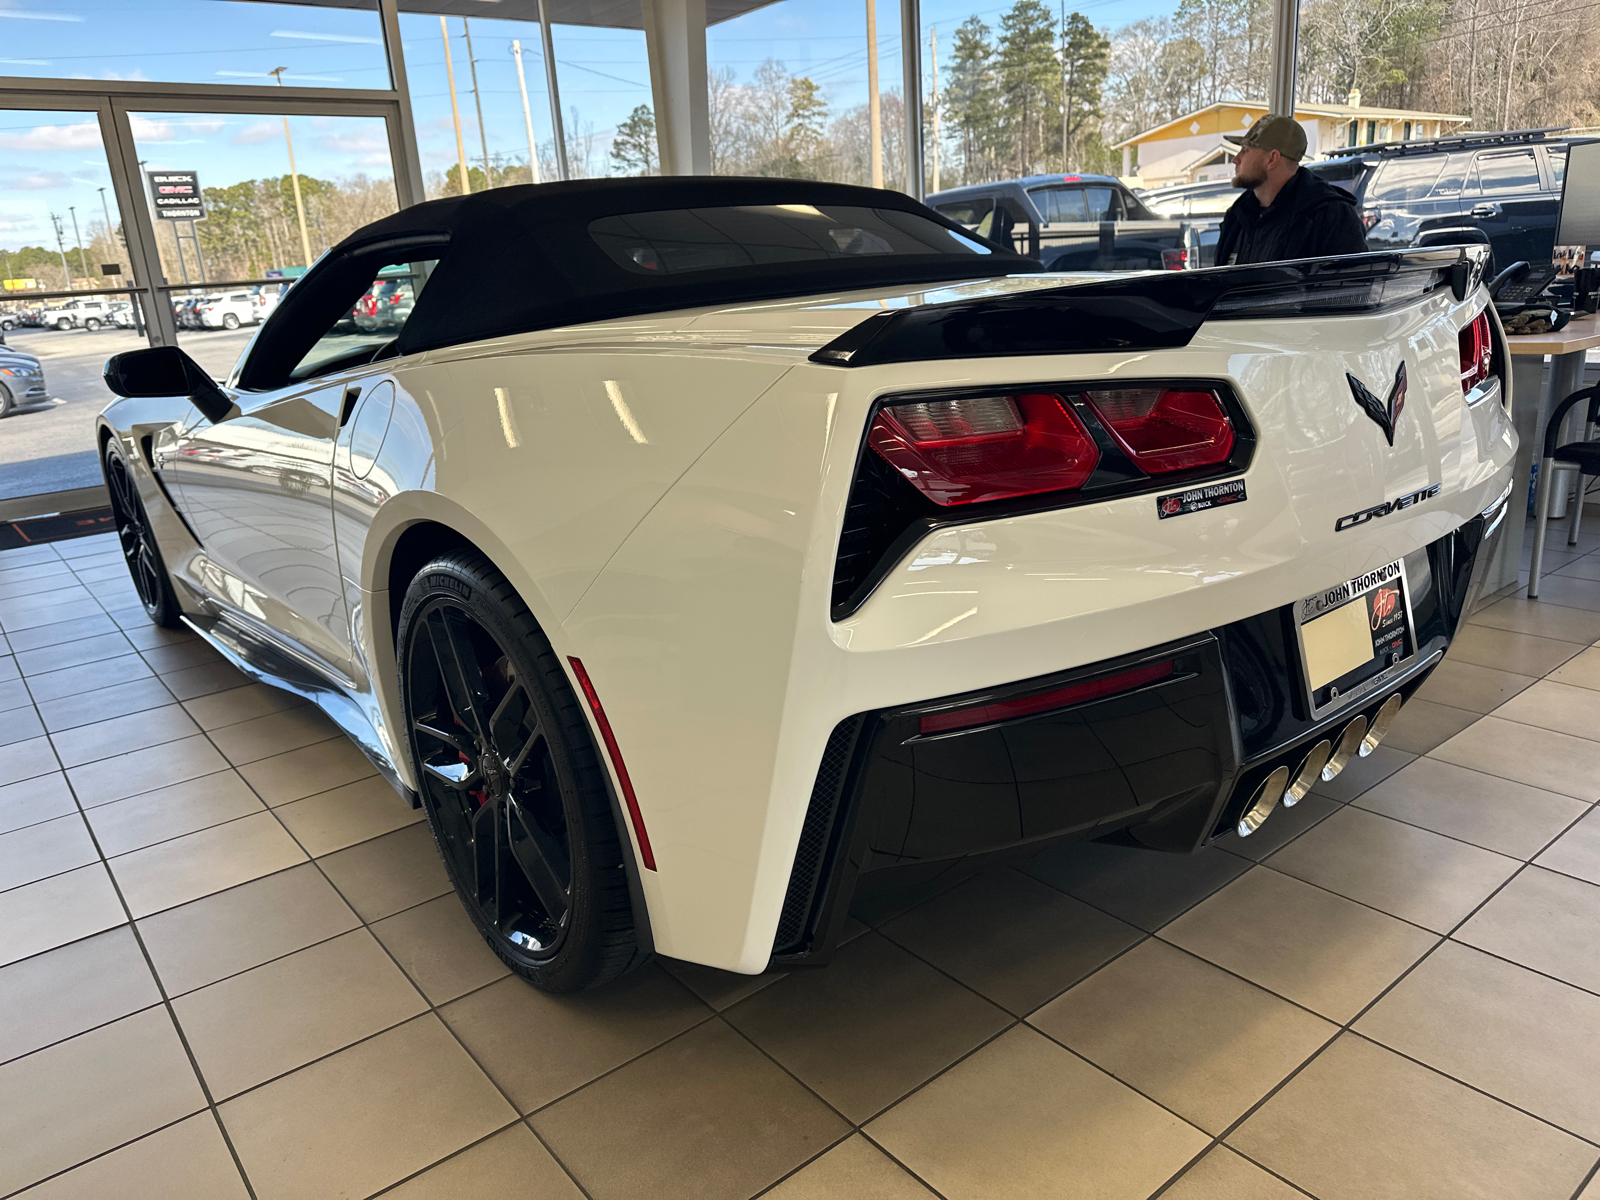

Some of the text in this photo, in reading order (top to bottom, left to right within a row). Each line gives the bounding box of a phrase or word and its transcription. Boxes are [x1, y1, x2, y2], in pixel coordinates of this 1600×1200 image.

[159, 185, 194, 194] GMC
[157, 197, 200, 205] CADILLAC
[162, 209, 201, 217] THORNTON
[1182, 481, 1244, 503] JOHN THORNTON
[1197, 500, 1212, 509] BUICK
[1335, 481, 1441, 532] CORVETTE
[429, 576, 472, 598] MICHELIN
[1323, 561, 1401, 607] JOHN THORNTON
[493, 617, 514, 645] SPORT
